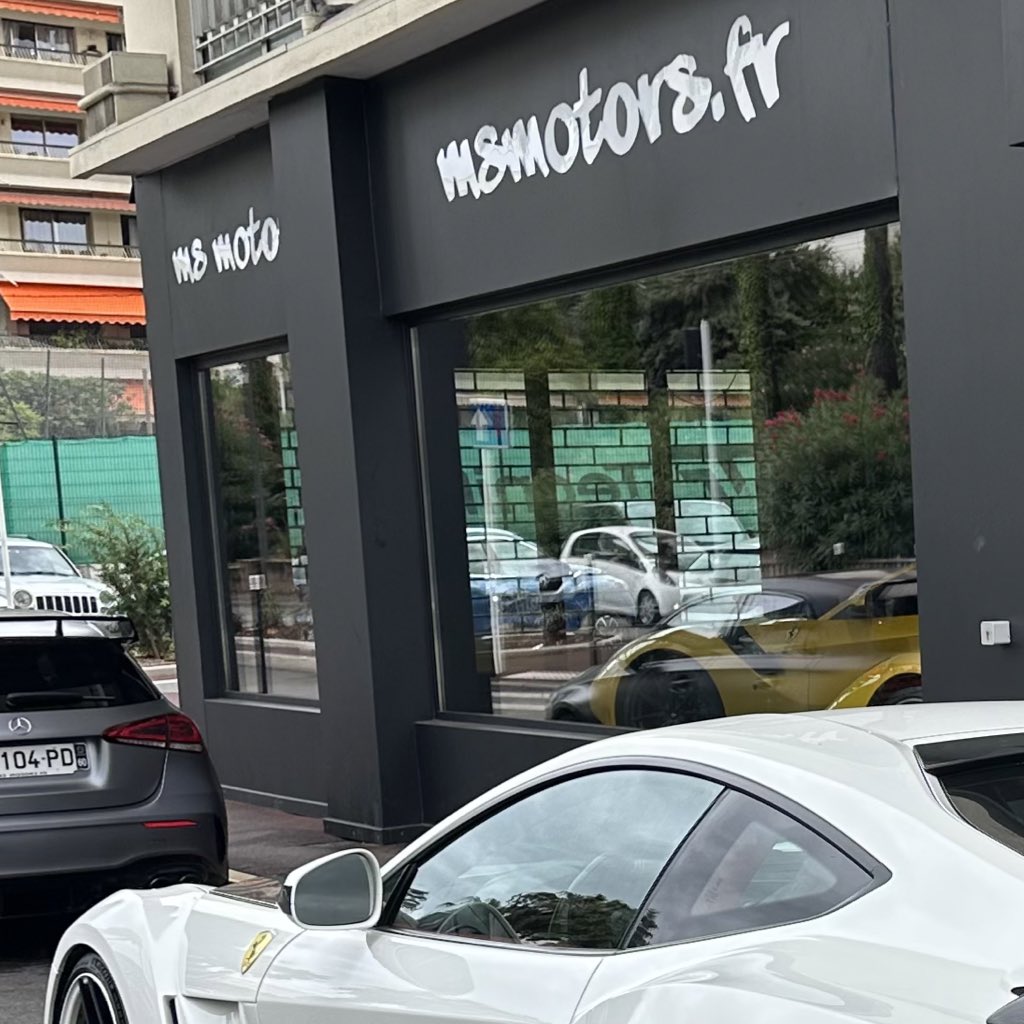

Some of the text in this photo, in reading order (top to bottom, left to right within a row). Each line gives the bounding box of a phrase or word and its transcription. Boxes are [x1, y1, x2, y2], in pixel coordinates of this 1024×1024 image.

[172, 207, 279, 284] ms moto
[1, 748, 74, 770] 104-PD
